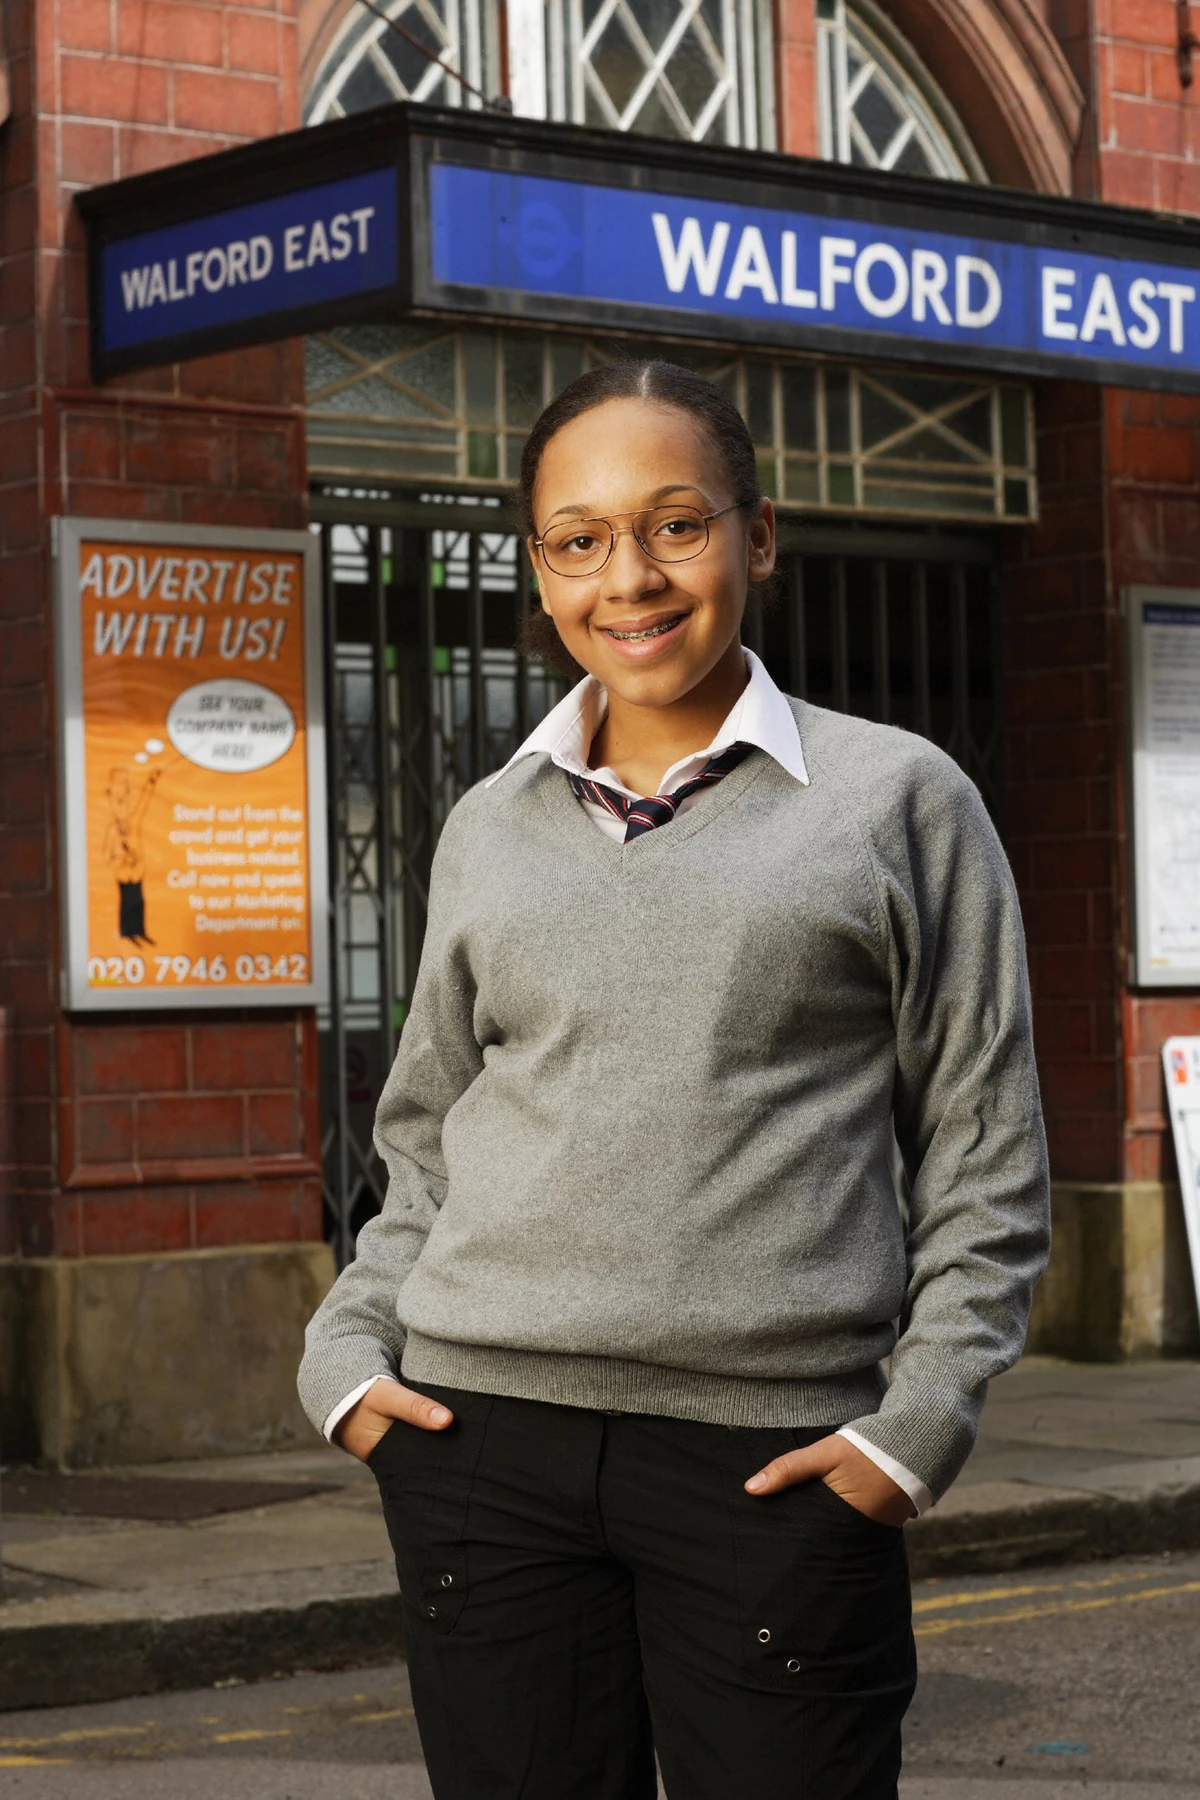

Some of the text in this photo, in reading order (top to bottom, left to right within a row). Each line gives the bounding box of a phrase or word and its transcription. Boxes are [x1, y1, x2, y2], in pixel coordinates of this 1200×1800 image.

[121, 207, 375, 312] WALFORD EAST
[651, 212, 1196, 353] WALFORD EAST
[80, 552, 296, 605] ADVERTISE
[94, 611, 285, 662] WITH US!
[153, 954, 228, 984] 7946
[234, 953, 307, 981] 0342
